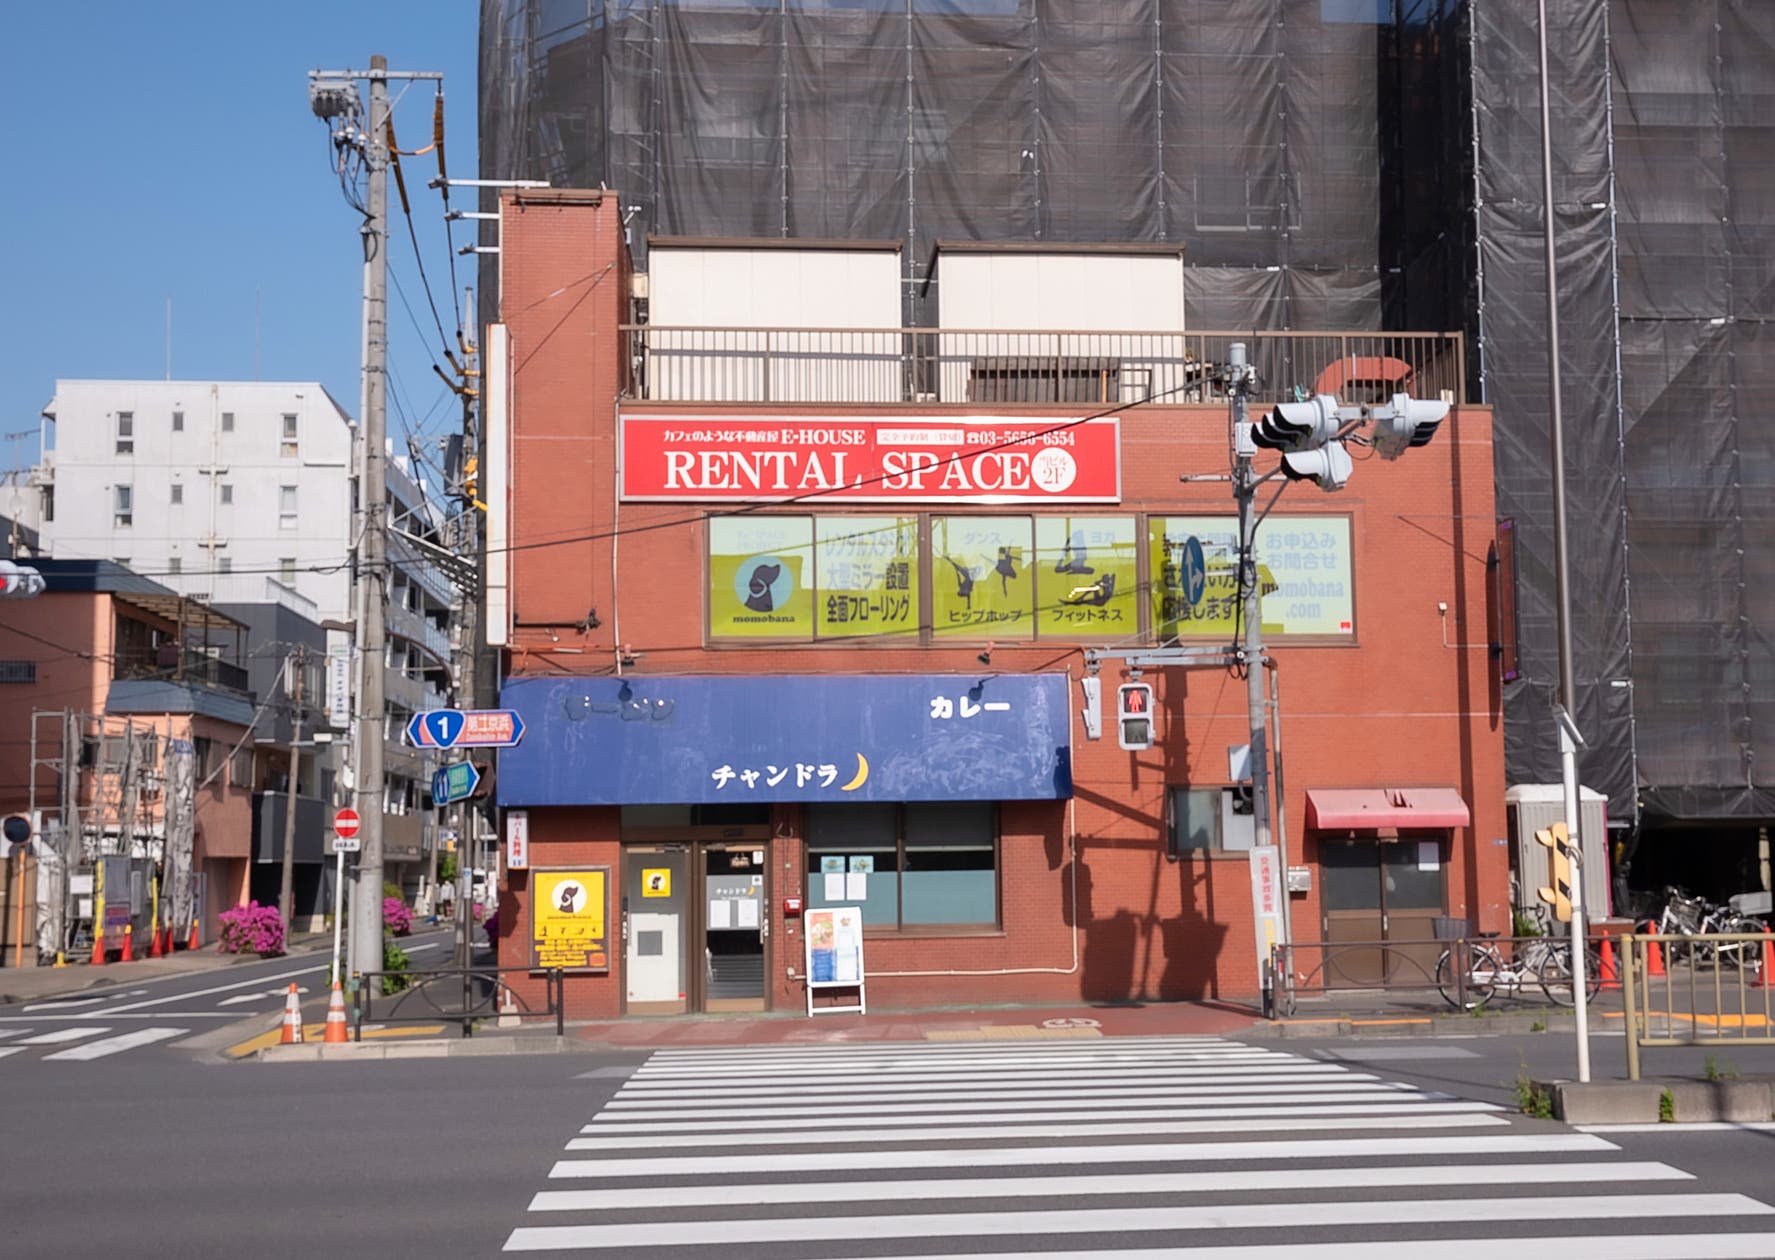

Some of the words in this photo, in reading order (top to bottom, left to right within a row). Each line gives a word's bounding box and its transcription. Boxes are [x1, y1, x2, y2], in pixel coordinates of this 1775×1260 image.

[663, 429, 779, 444] カフェのような不動産屋
[663, 451, 862, 489] RENTAL
[881, 451, 1030, 489] SPACE
[1043, 467, 1063, 484] 2F
[1266, 531, 1336, 550] お申込み
[1266, 552, 1336, 569] お問合せ
[826, 562, 910, 591] 大型ミラー設置
[1261, 577, 1344, 597] momobana
[827, 594, 910, 623] 全面フローリング
[949, 609, 1023, 623] ヒップホップ
[1052, 609, 1124, 623] フィットネス
[1286, 603, 1321, 619] .com
[733, 614, 796, 623] momobana
[930, 696, 1011, 719] カレー
[437, 716, 449, 739] 1
[711, 764, 838, 790] チャンドラ
